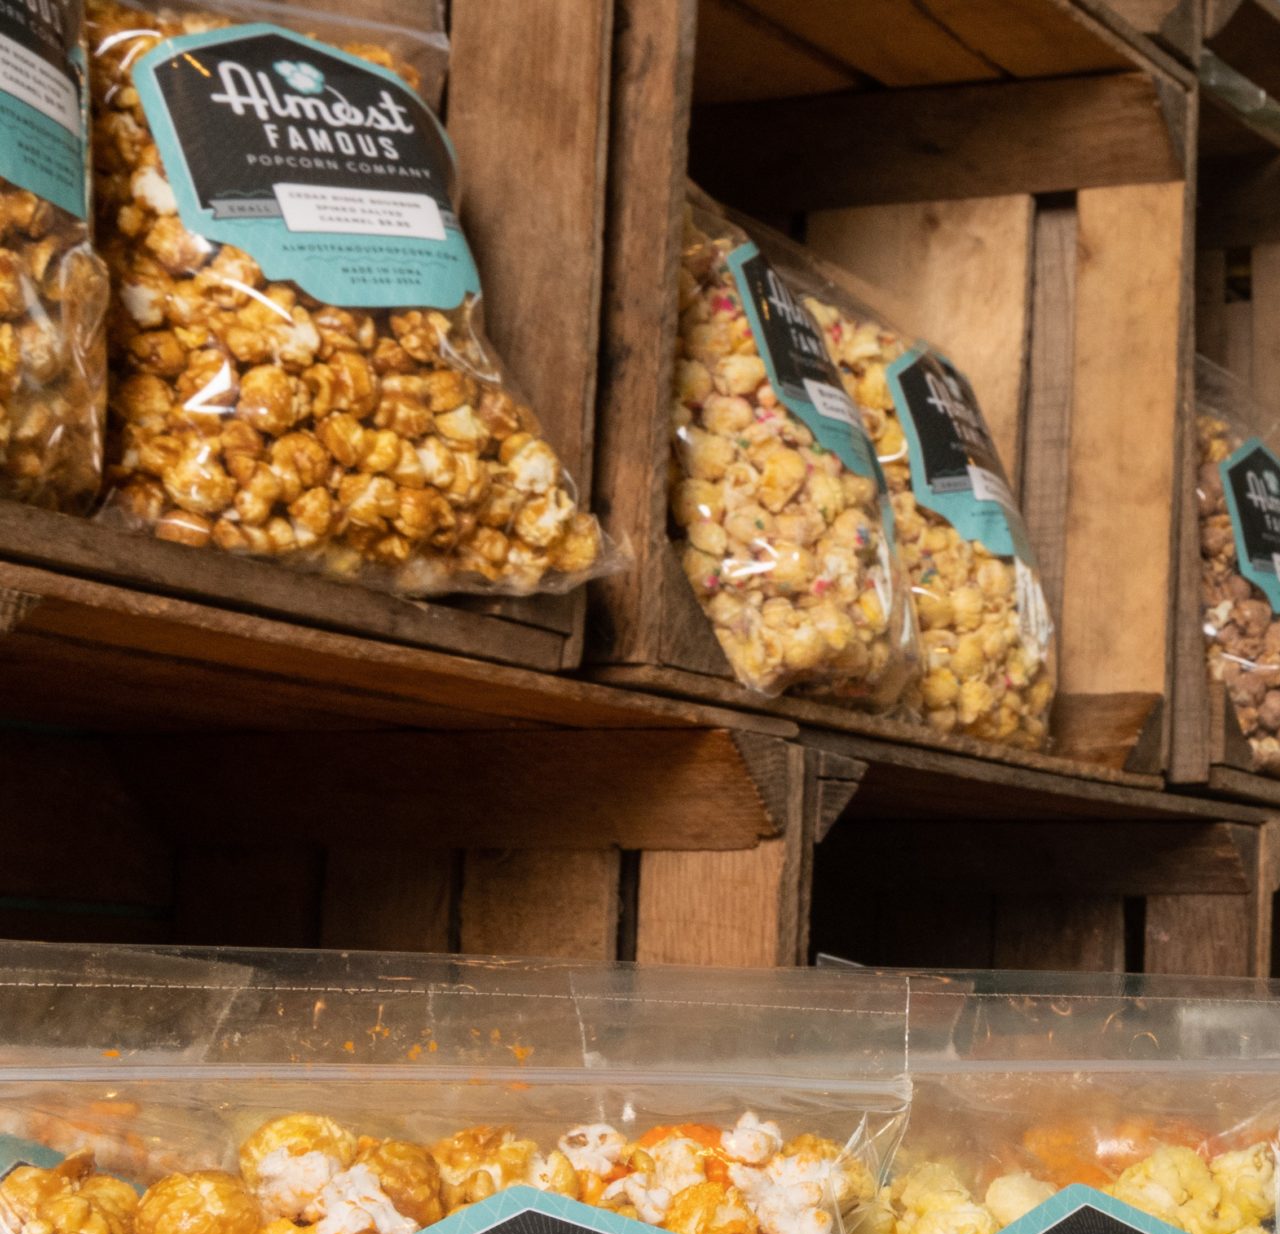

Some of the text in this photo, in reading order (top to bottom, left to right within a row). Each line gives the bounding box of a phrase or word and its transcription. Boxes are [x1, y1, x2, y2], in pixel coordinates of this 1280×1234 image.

[210, 60, 414, 134] Almost
[264, 123, 399, 160] FAMOUS
[246, 153, 431, 179] POPCORN COMPANY
[229, 204, 271, 213] SMALL
